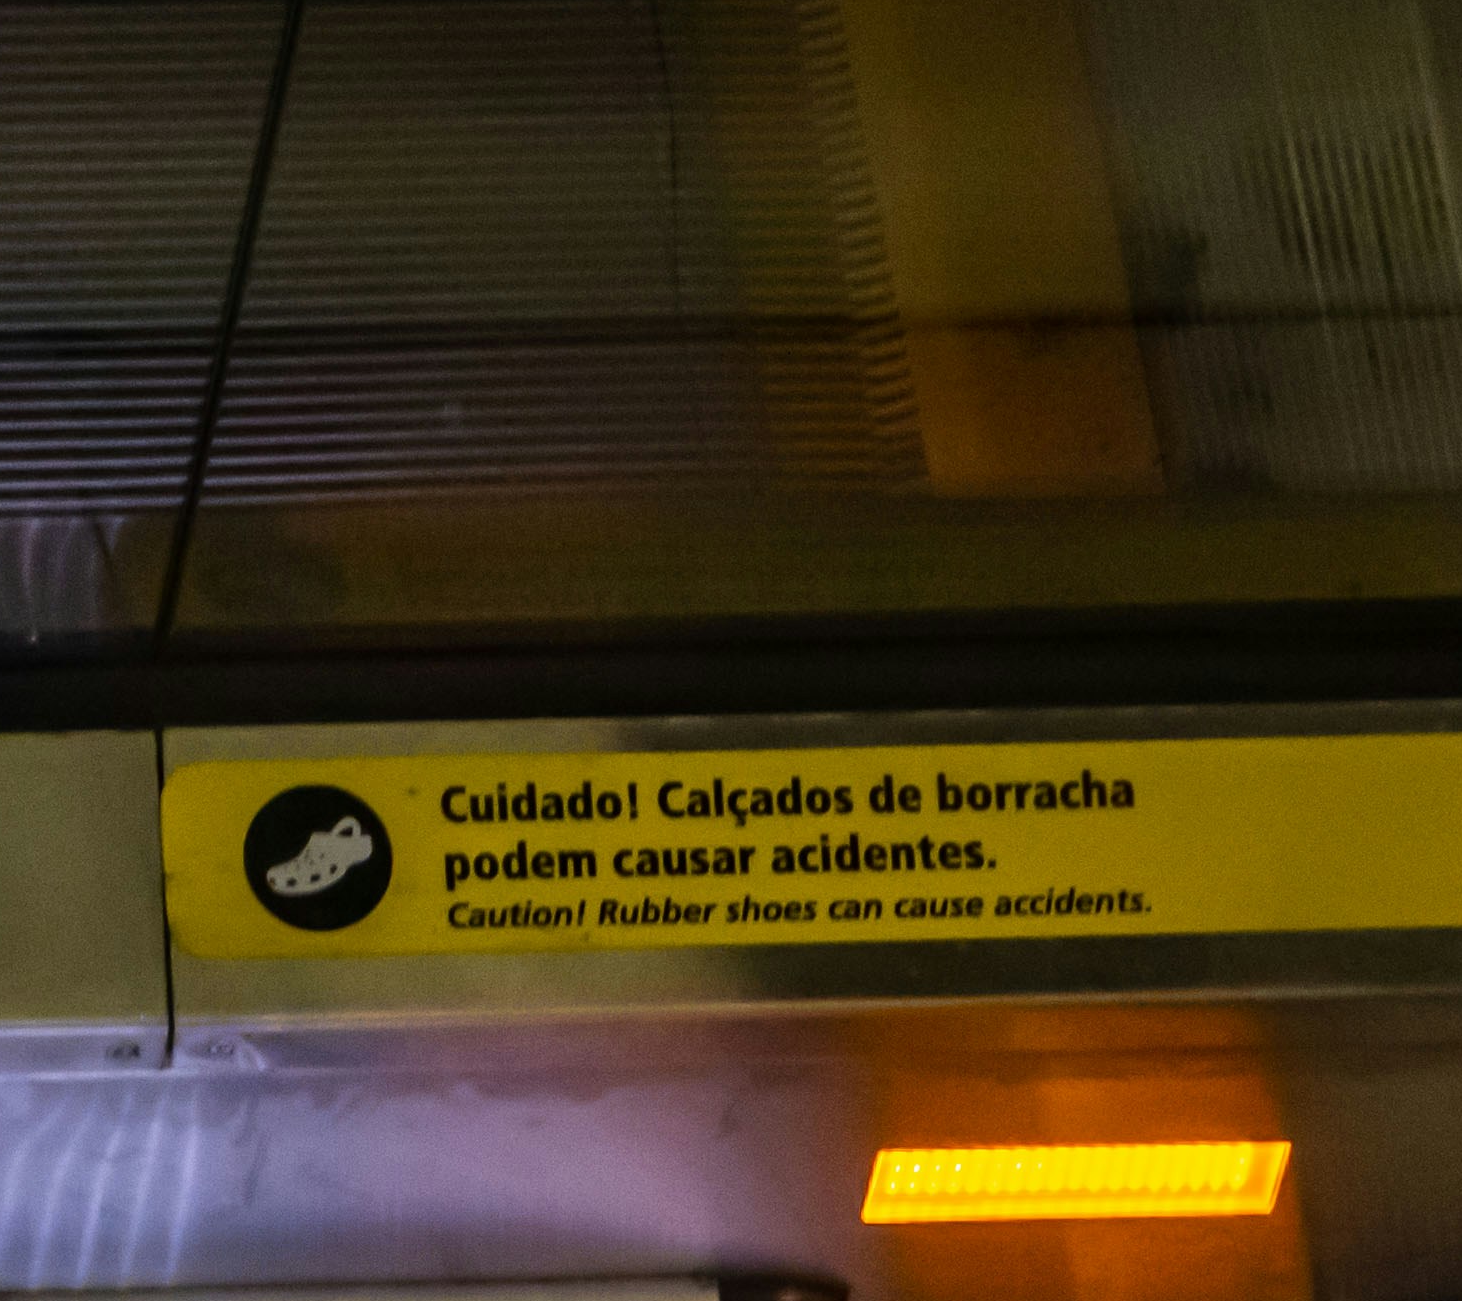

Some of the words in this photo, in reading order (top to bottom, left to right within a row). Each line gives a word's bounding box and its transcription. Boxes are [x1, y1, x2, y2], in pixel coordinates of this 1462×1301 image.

[440, 781, 638, 823] Cuidado!
[657, 776, 854, 827] Calçados
[869, 773, 921, 814] de
[937, 769, 1135, 812] borracha
[444, 840, 597, 891] podem
[612, 845, 756, 876] causar
[772, 832, 997, 874] acidentes.
[447, 900, 586, 928] Caution!
[598, 897, 717, 926] Rubber
[726, 894, 817, 923] shoes
[828, 897, 883, 920] can
[894, 895, 984, 919] cause
[994, 886, 1153, 916] accidents.
